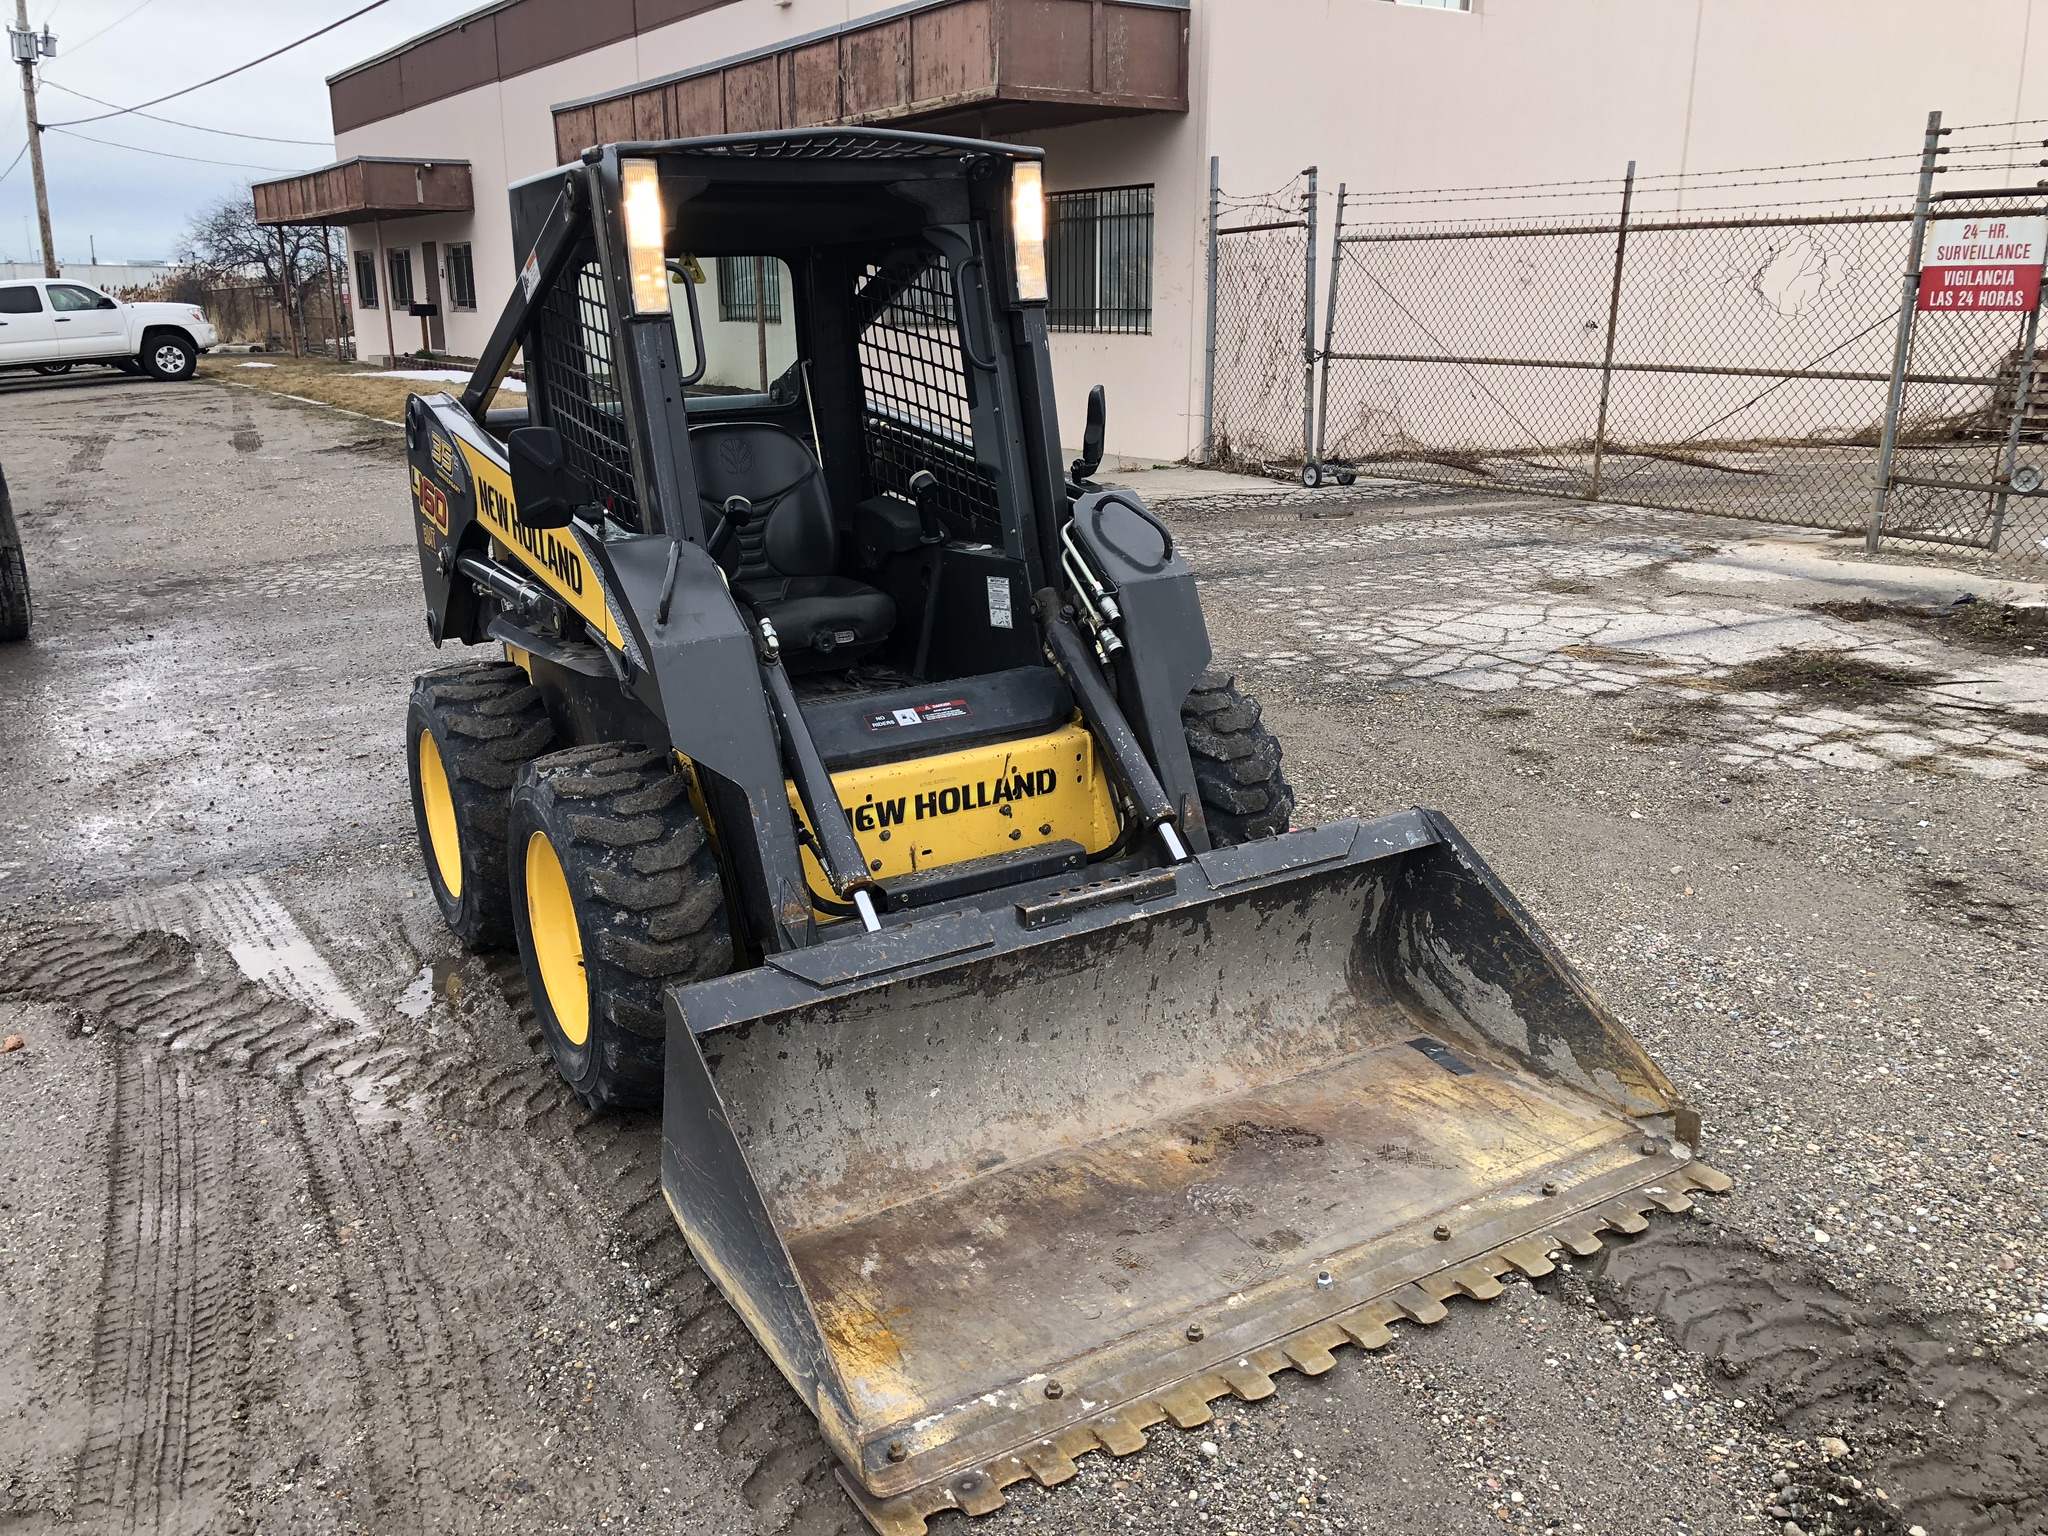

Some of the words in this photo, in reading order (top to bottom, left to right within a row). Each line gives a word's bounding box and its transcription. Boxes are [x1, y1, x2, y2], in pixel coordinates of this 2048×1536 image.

[1963, 223, 2009, 240] 24-HR.
[1937, 243, 2032, 261] SURVEILLANCE
[1944, 269, 2015, 286] VIGILANCIA
[1929, 290, 1954, 307] LAS
[1957, 290, 1974, 307] 24
[1978, 290, 2024, 307] HORAS
[477, 475, 509, 534] NEW
[510, 502, 583, 597] HOLLAND
[872, 720, 896, 728] RIDERS
[914, 767, 1057, 821] HOLLAND
